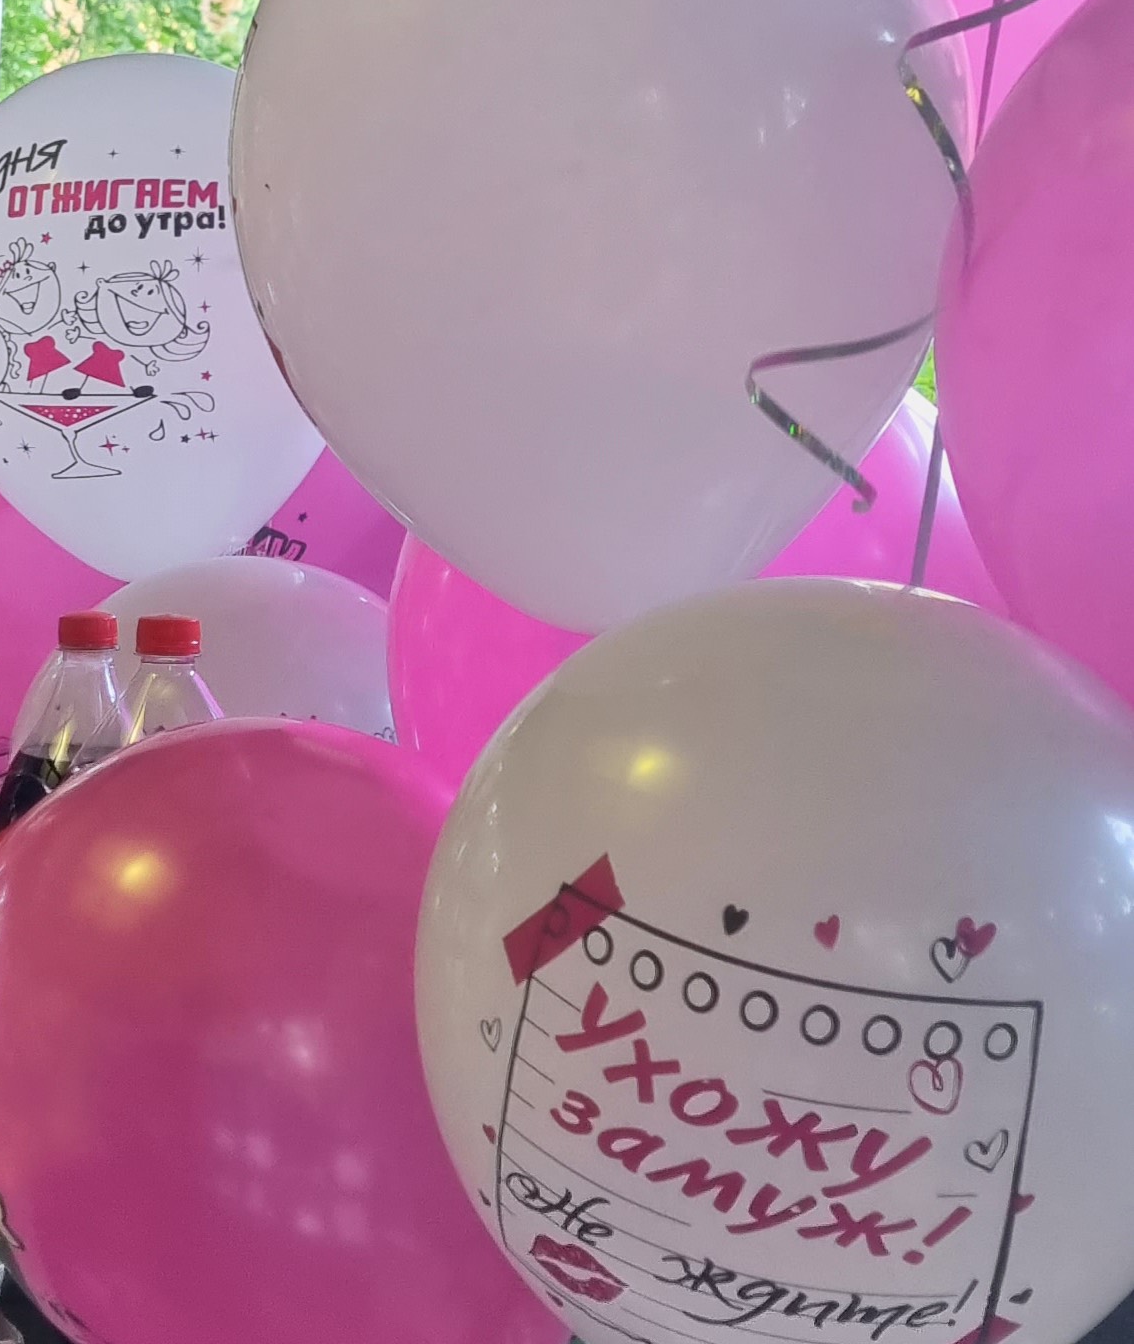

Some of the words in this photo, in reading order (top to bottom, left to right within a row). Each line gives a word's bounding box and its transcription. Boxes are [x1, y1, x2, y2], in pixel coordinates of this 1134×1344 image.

[7, 178, 219, 218] ОТЖИГАЕМ
[84, 212, 127, 241] до
[136, 204, 226, 240] утра!
